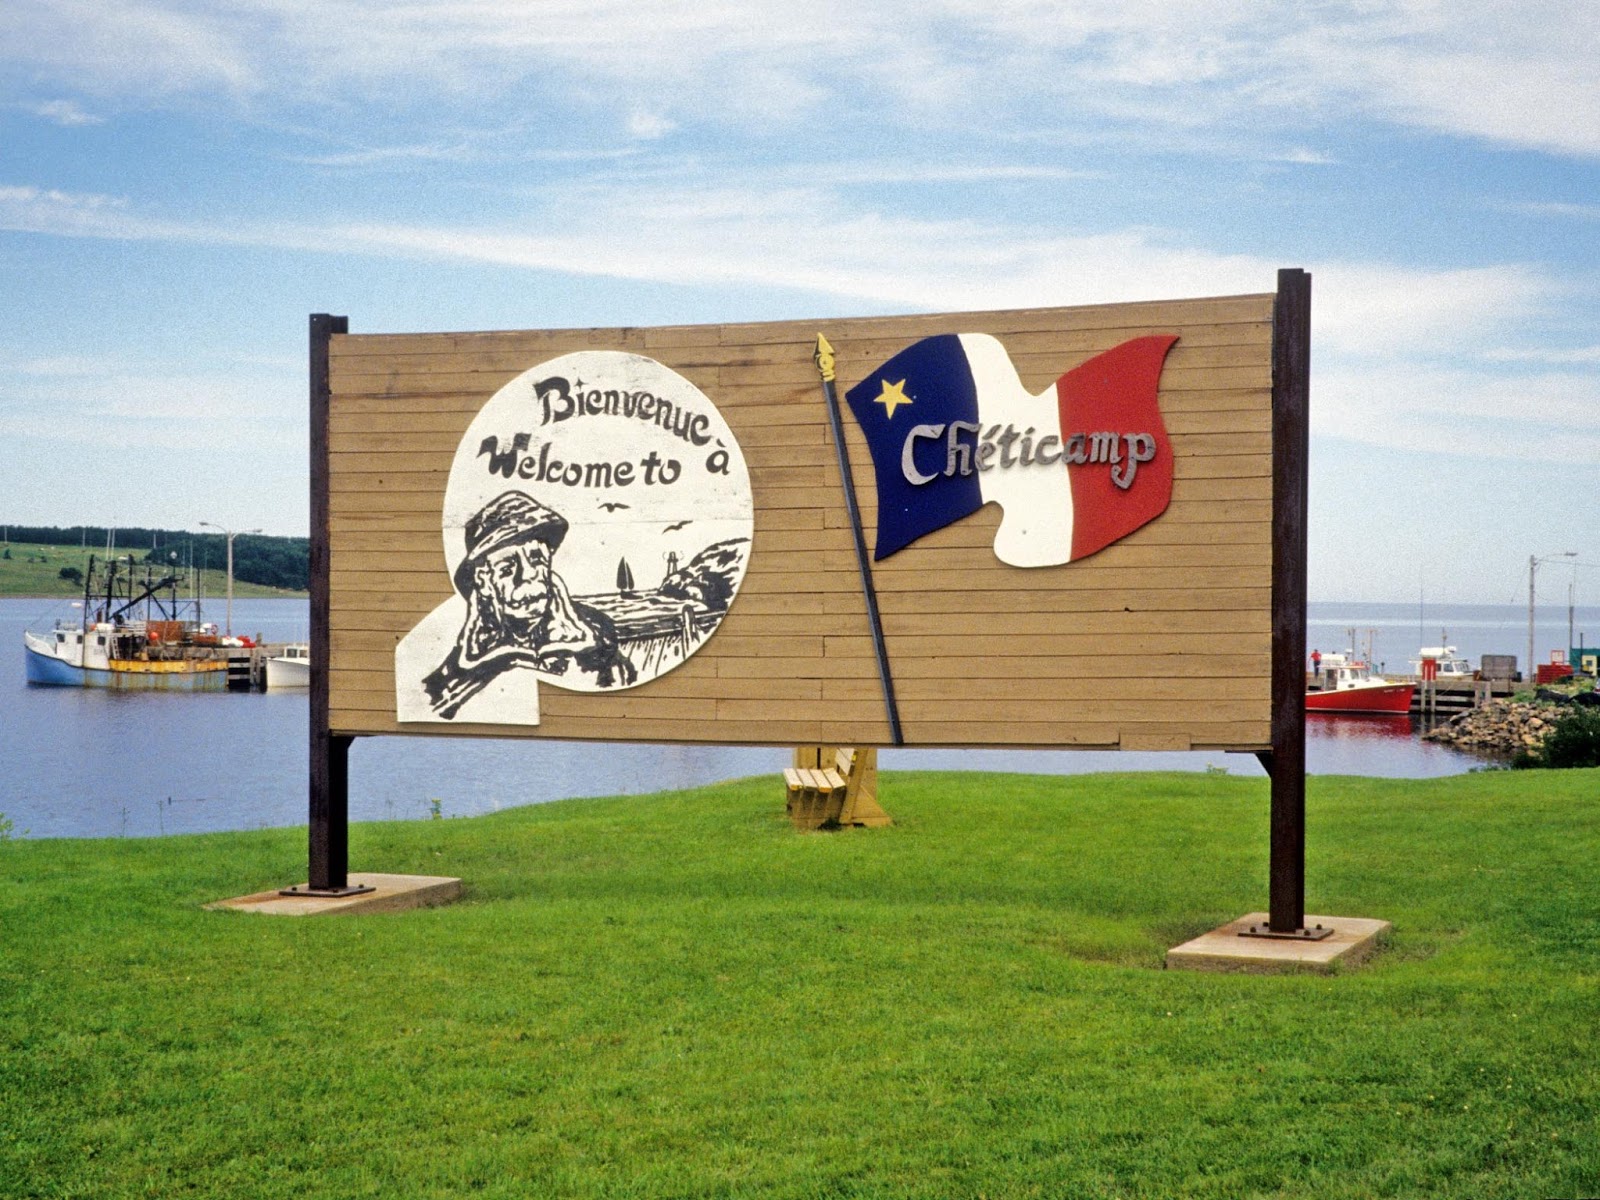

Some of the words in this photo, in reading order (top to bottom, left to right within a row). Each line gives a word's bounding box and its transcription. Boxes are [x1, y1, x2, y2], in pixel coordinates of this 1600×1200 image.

[476, 432, 634, 488] Welcome
[640, 451, 682, 485] to
[532, 376, 711, 447] Bienvenue
[705, 438, 730, 475] à
[901, 419, 1157, 490] Chéticamp
